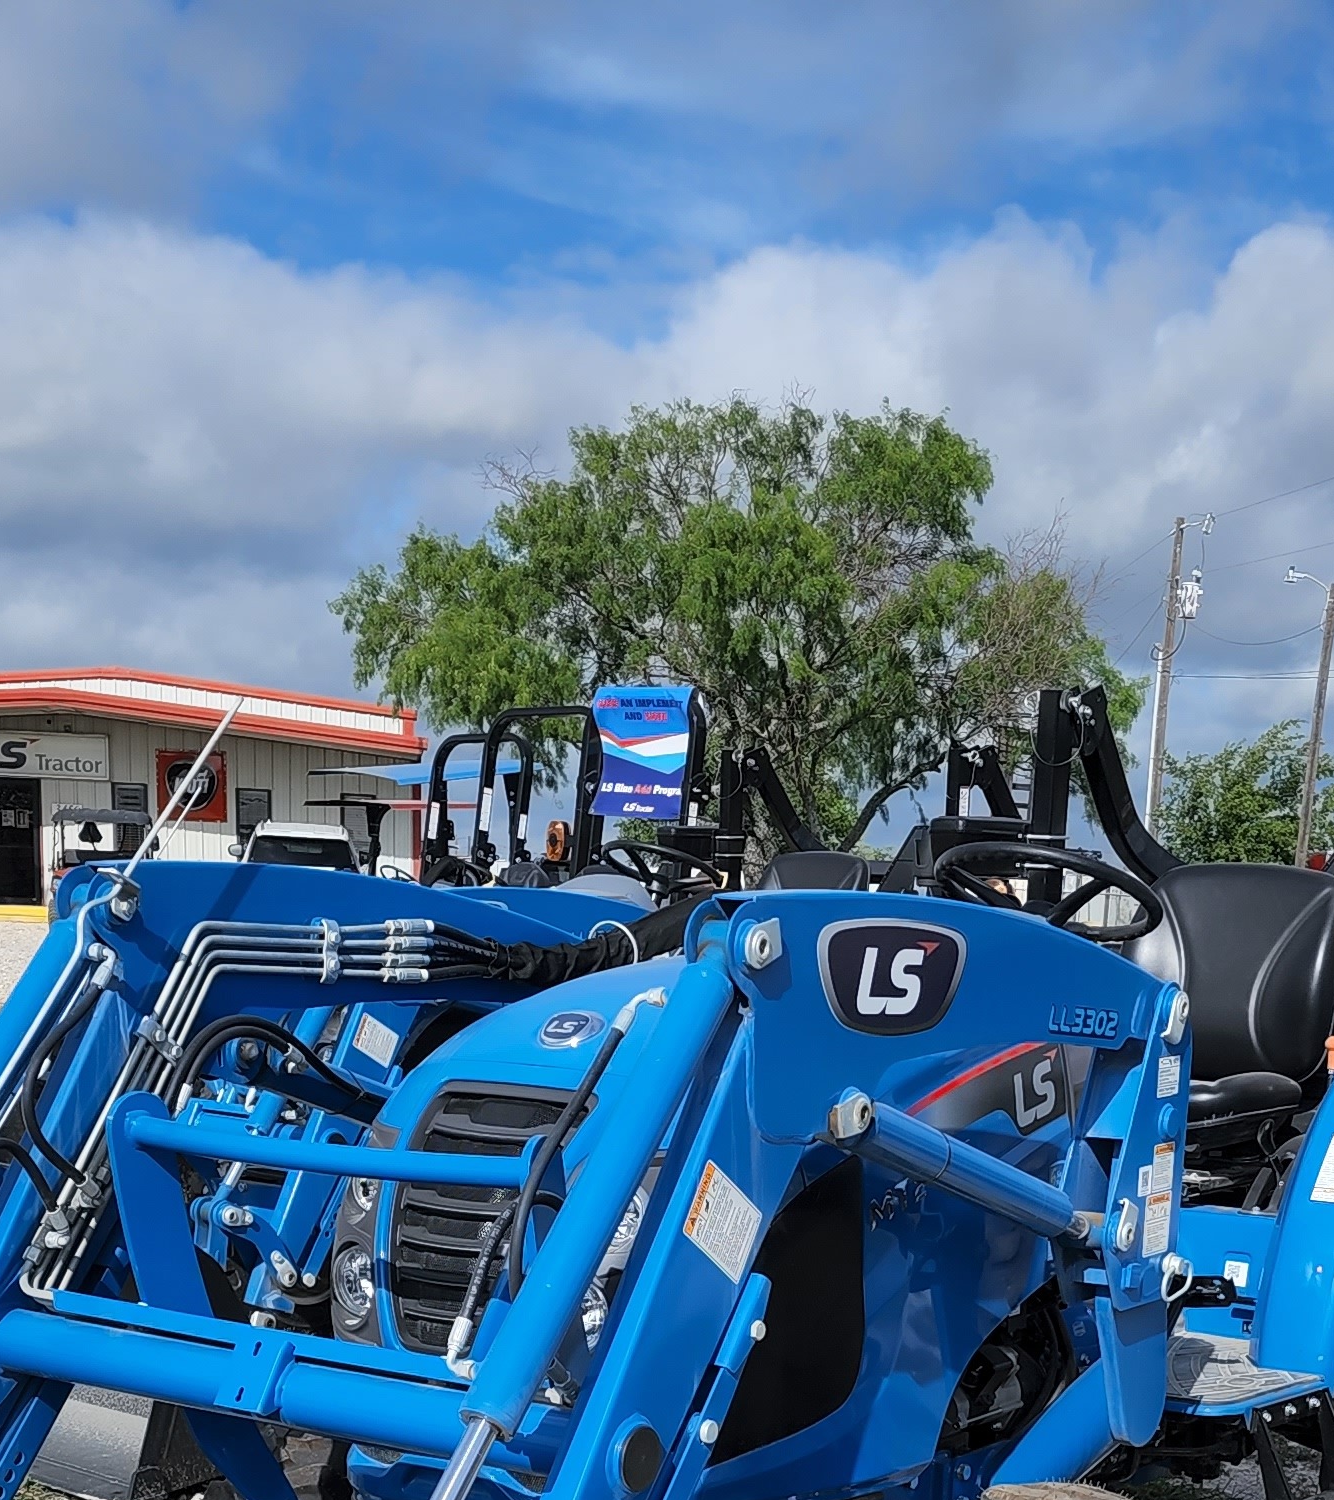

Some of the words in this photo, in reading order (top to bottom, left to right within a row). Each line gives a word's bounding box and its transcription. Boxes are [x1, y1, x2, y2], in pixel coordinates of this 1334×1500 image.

[624, 711, 642, 720] AND
[35, 754, 102, 773] Tractor
[601, 783, 613, 792] LS
[857, 947, 924, 1015] LS
[546, 1020, 579, 1034] LS
[1048, 1005, 1119, 1037] LL3302
[1014, 1058, 1056, 1128] LS
